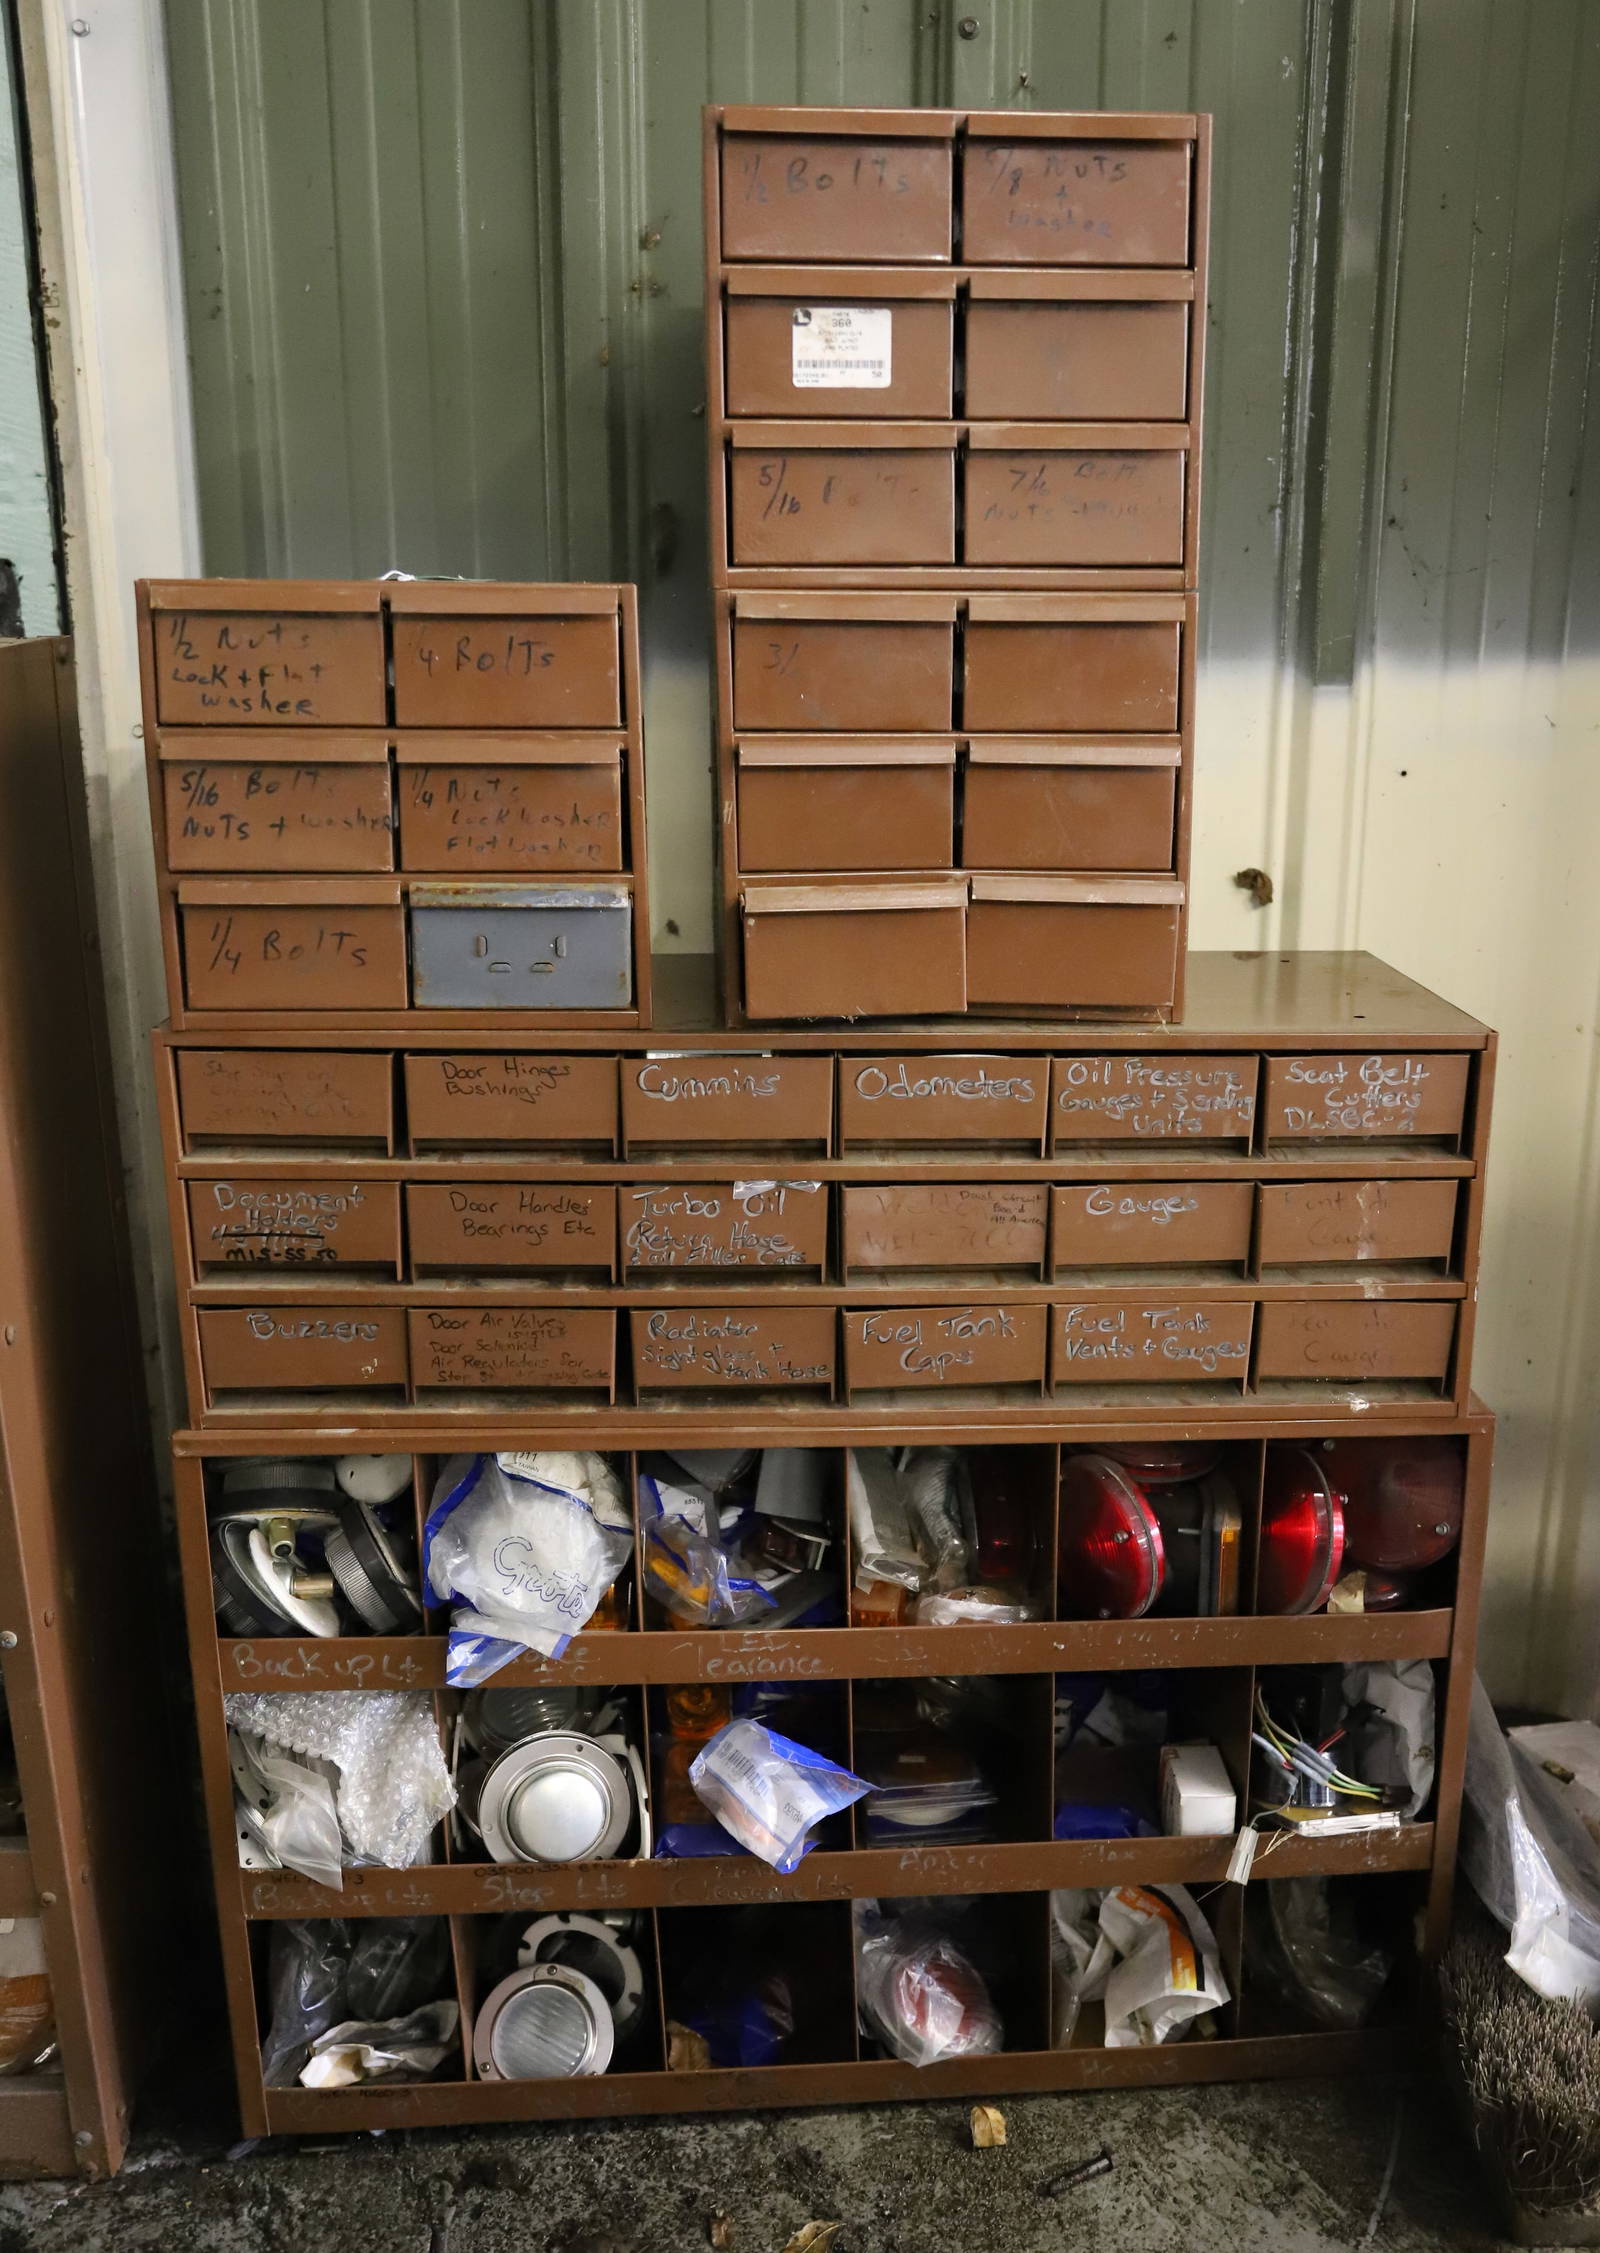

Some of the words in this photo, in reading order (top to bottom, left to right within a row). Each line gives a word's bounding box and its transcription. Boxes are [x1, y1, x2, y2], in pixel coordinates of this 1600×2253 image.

[169, 617, 200, 660] 1/2
[180, 768, 220, 809] 5/16
[411, 768, 434, 808] 1/4
[269, 815, 287, 837] +
[209, 916, 241, 975] 1/4
[441, 1060, 488, 1081] Door
[504, 1057, 572, 1090] Hinges
[637, 1063, 782, 1102] Cummins
[855, 1063, 1037, 1103] Odometers
[1067, 1059, 1113, 1085] Oil
[1124, 1057, 1243, 1089] Pressure
[1284, 1061, 1349, 1085] Seat
[1359, 1055, 1431, 1086] Belt
[446, 1080, 544, 1104] Bushings
[1152, 1090, 1166, 1108] +
[1324, 1085, 1423, 1109] Cutters
[1132, 1109, 1204, 1136] Units
[213, 1183, 367, 1212] Document
[449, 1190, 499, 1214] Door
[519, 1190, 592, 1216] Handles
[632, 1186, 721, 1218] Turbo
[742, 1187, 786, 1217] Oil
[1085, 1186, 1199, 1225] Gauges
[246, 1208, 338, 1230] Holders
[462, 1218, 550, 1246] Bearings
[627, 1220, 713, 1251] Return
[730, 1220, 795, 1252] Hose
[246, 1311, 380, 1342] Buzzers
[427, 1312, 469, 1330] Door
[480, 1312, 503, 1328] Air
[647, 1312, 759, 1341] Radiator
[863, 1313, 923, 1345] Fuel
[937, 1309, 1019, 1339] Tank
[1064, 1306, 1126, 1334] Fuel
[1142, 1306, 1212, 1334] Tank
[429, 1341, 465, 1355] Door
[432, 1354, 451, 1369] Air
[900, 1346, 974, 1380] Caps
[1066, 1336, 1136, 1362] Vents
[1160, 1337, 1248, 1373] Gauges
[777, 1360, 833, 1379] Hose
[232, 1642, 330, 1679] Back
[333, 1653, 376, 1688] up
[482, 1875, 555, 1907] Stop
